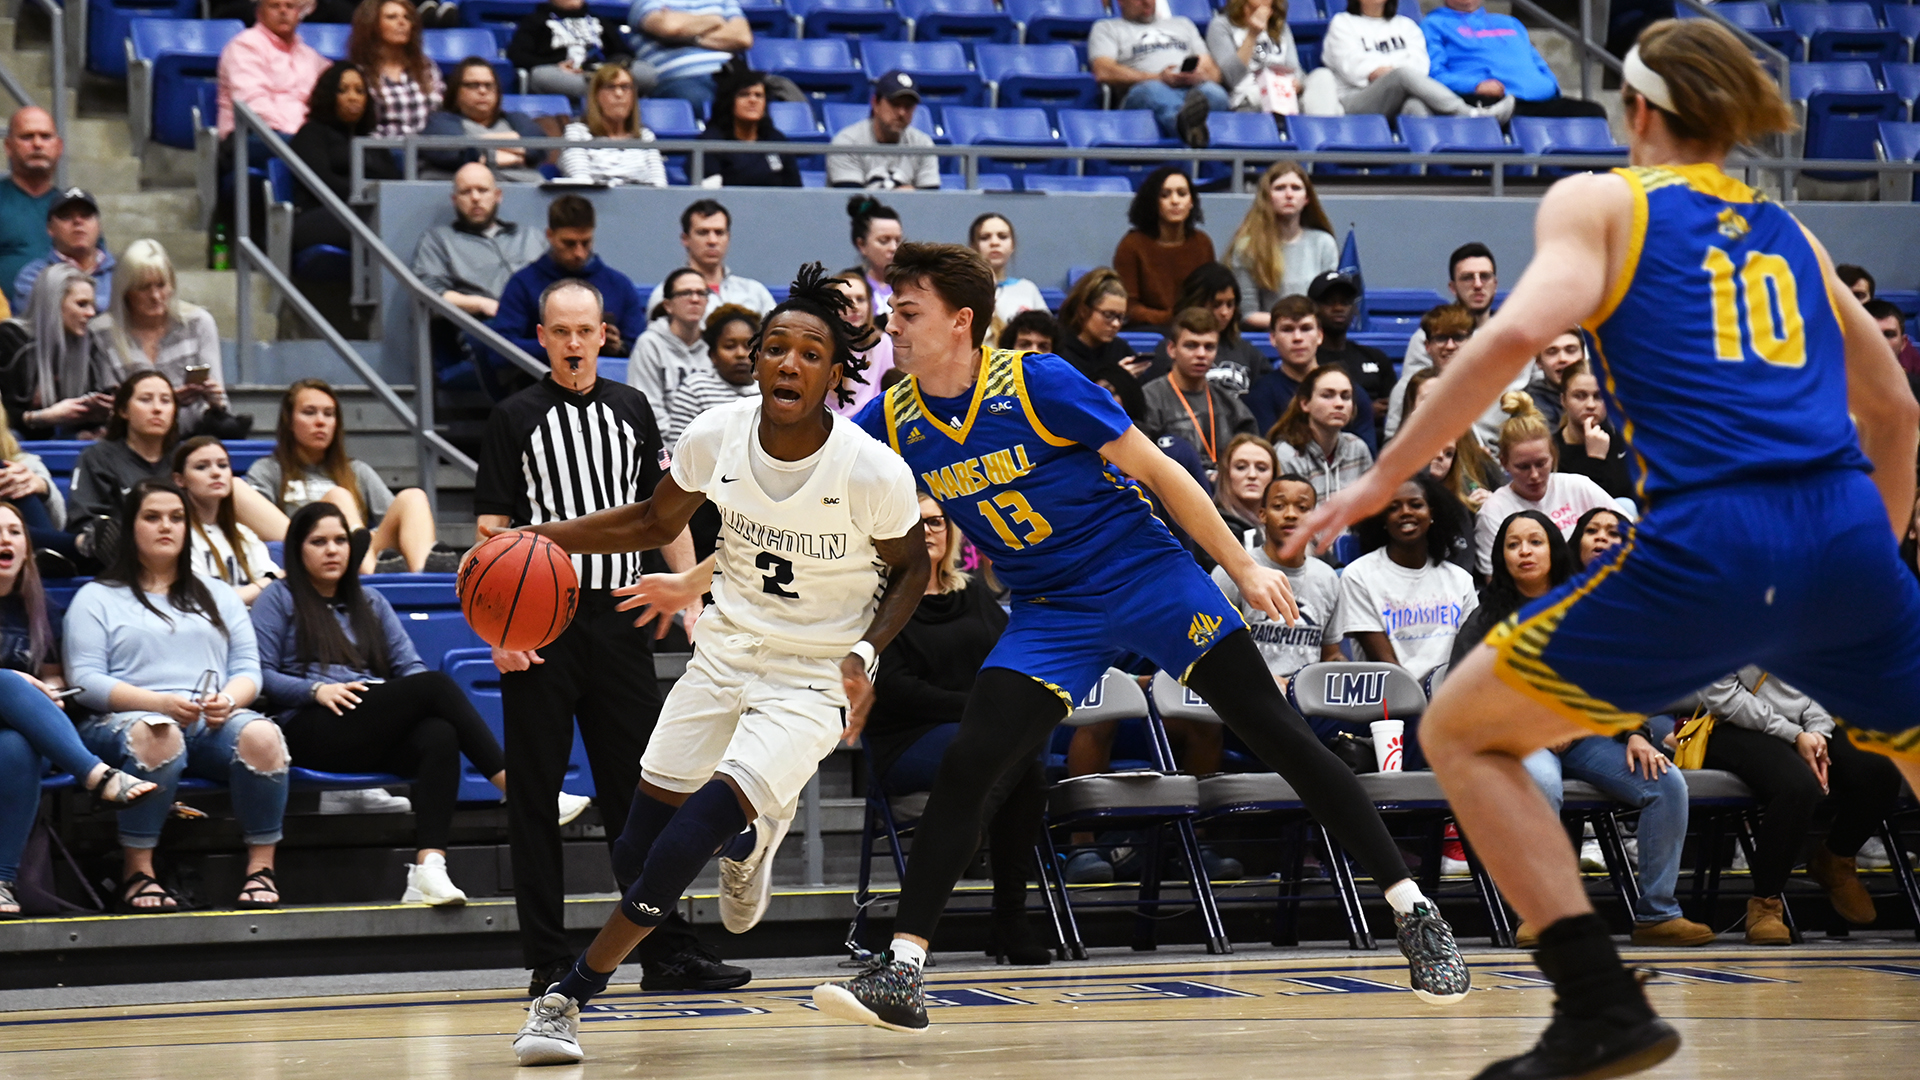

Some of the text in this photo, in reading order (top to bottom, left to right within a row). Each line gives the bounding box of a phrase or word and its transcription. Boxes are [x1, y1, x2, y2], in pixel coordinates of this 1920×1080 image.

[1701, 245, 1807, 369] 10
[990, 400, 1013, 413] SAC
[921, 444, 1037, 501] MARS HILL
[823, 497, 840, 505] SAC
[977, 490, 1053, 550] 13
[755, 551, 800, 599] 2
[1382, 602, 1461, 636] THRASHER
[1324, 671, 1391, 708] LMU
